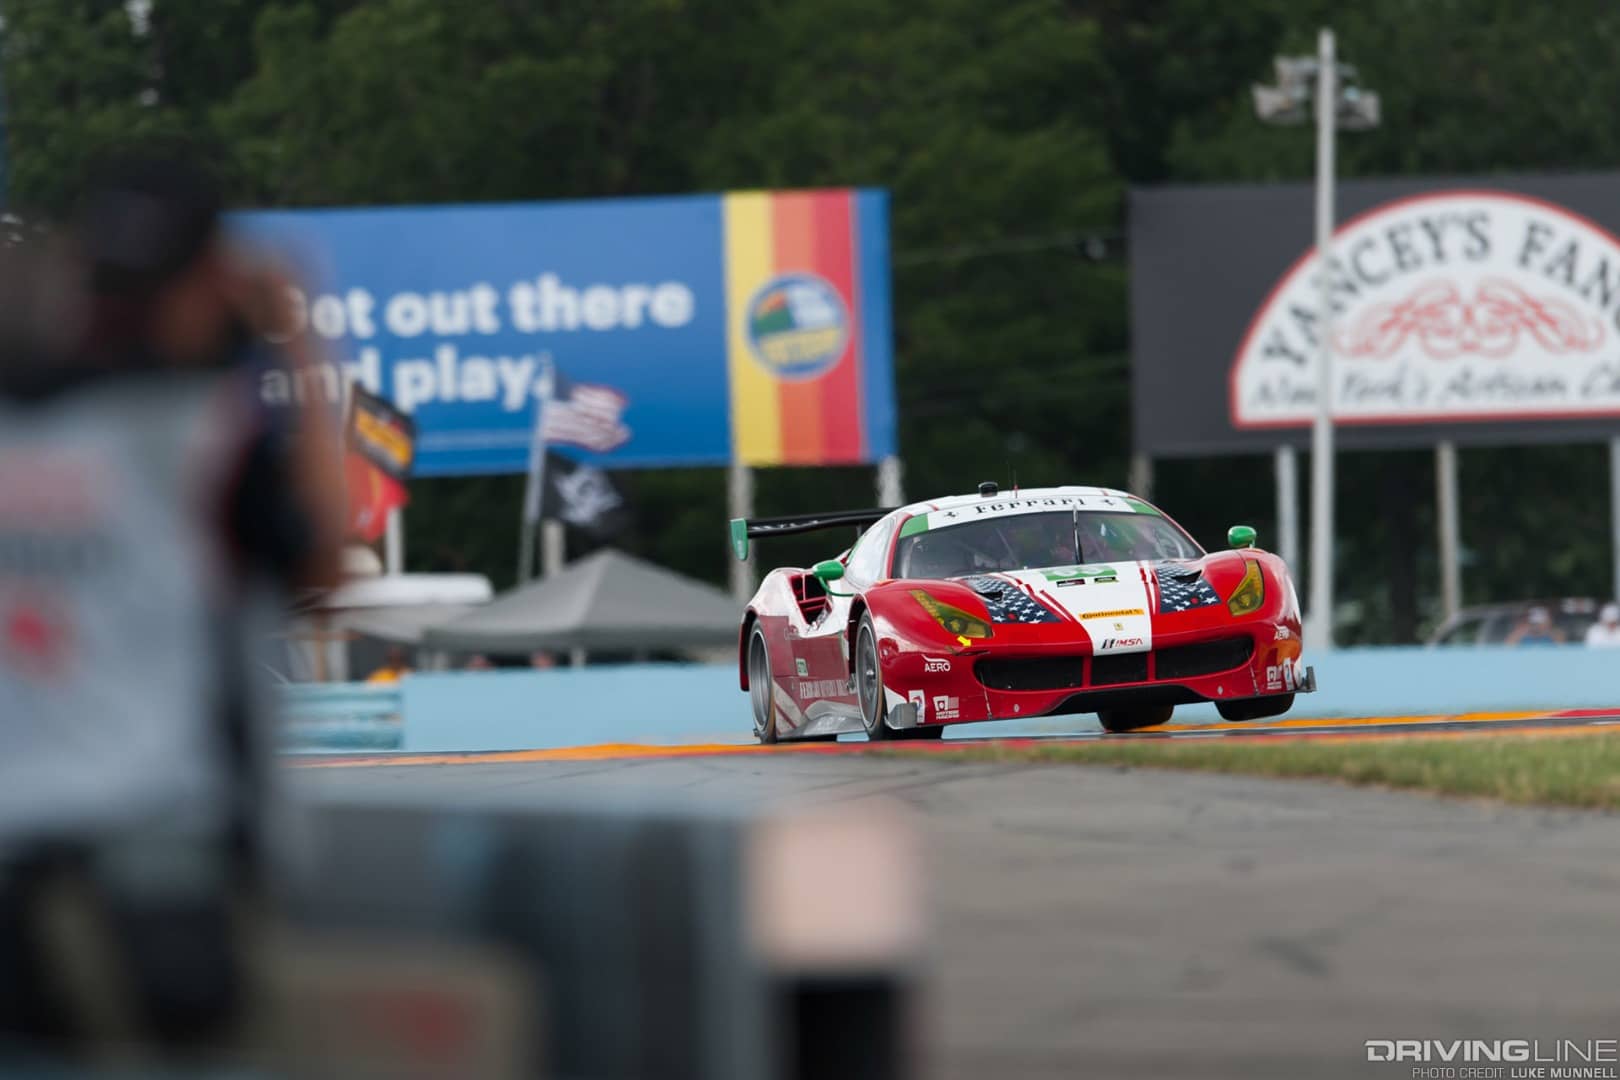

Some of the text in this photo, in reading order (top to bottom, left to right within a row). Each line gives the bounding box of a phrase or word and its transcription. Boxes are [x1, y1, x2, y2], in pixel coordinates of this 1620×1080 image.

[1262, 209, 1492, 366] YANCEY'S
[386, 288, 499, 339] out
[510, 273, 694, 330] there
[975, 497, 1088, 515] Ferrari
[1081, 608, 1134, 620] Continental
[924, 662, 952, 673] AERO
